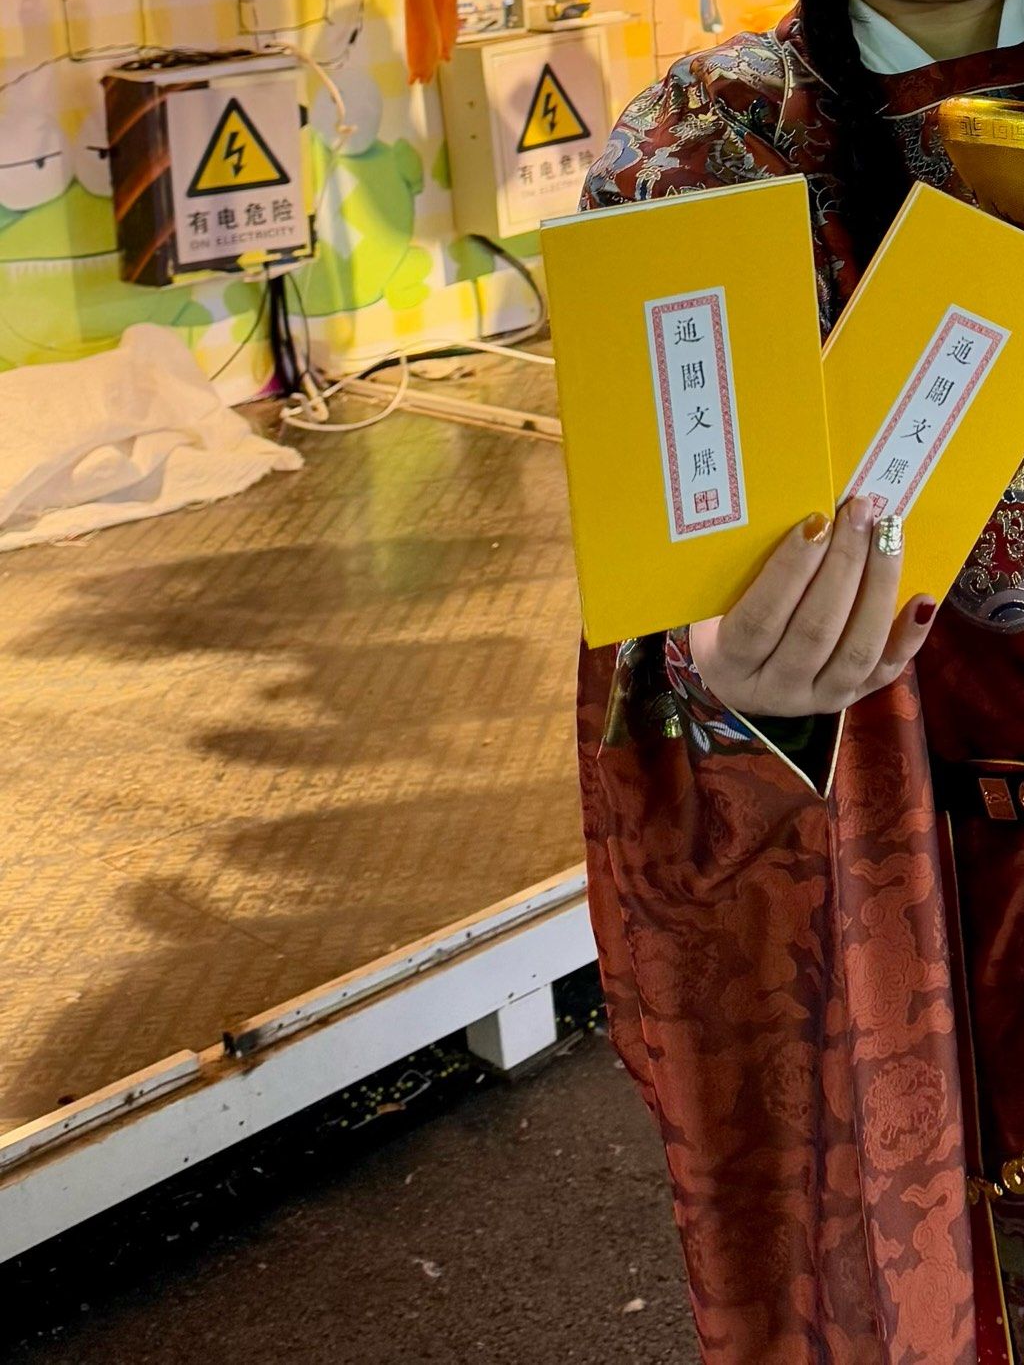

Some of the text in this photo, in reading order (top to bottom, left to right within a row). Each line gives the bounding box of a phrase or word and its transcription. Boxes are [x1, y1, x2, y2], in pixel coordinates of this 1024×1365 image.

[188, 198, 293, 234] 有电危险
[216, 226, 294, 246] ELECTRICITY
